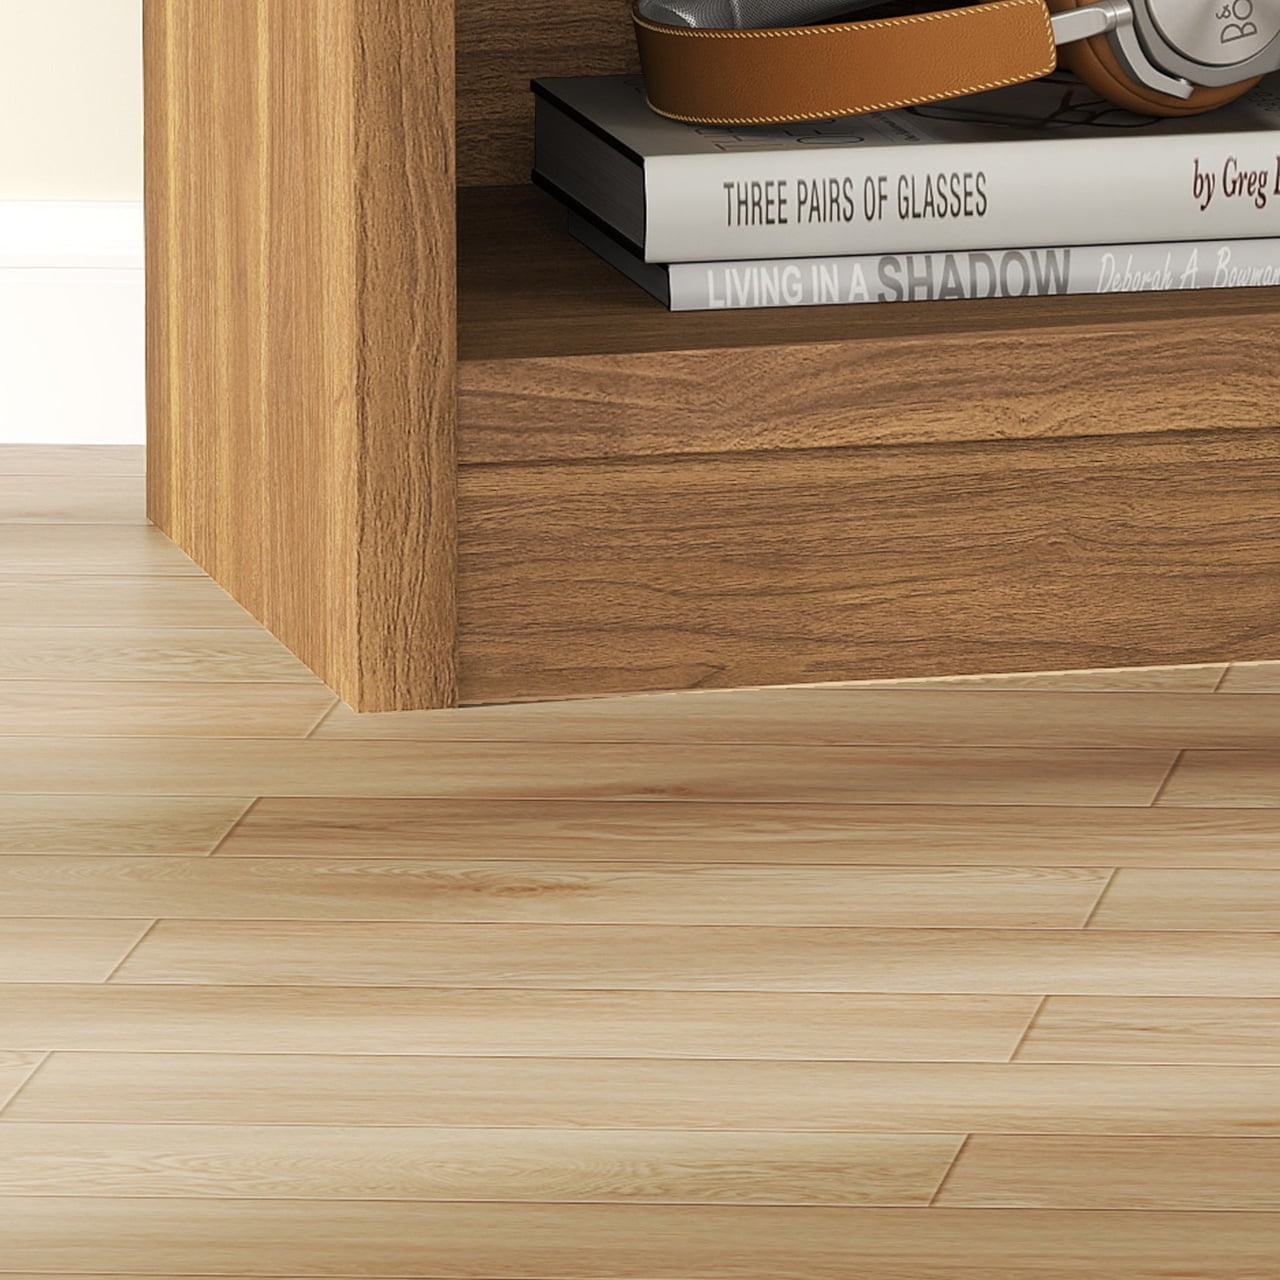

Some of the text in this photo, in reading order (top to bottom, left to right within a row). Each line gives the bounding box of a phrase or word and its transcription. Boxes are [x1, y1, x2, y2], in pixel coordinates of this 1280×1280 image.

[723, 171, 987, 227] THREE PAIRS OF GLASSES
[1192, 160, 1217, 210] by
[1223, 157, 1267, 209] Greg
[707, 249, 1071, 308] LIVING IN A SHADOW
[1096, 252, 1173, 294] Deborah
